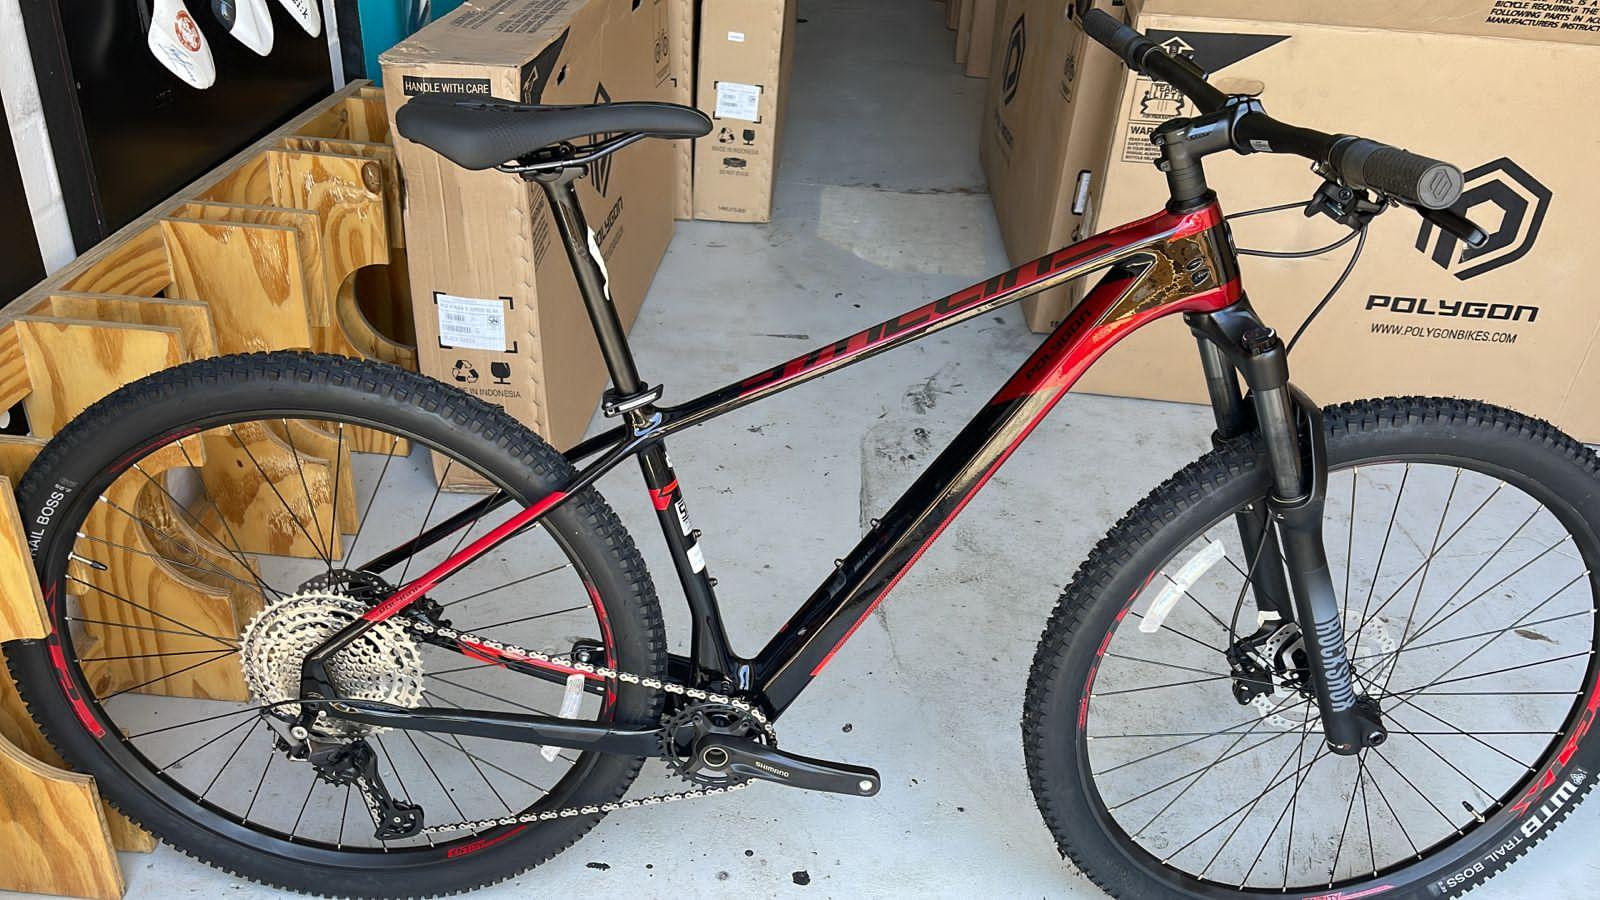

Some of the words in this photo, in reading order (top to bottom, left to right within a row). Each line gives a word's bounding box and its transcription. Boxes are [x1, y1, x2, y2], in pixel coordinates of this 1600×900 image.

[1490, 8, 1542, 18] FOLLOWING
[1543, 12, 1571, 21] PARTS
[1494, 1, 1531, 9] BICYCLE
[1531, 3, 1579, 13] REQUIRING
[1582, 7, 1600, 15] THE
[1485, 16, 1559, 28] MANUFACTURERS
[405, 81, 440, 93] HANDLE
[441, 83, 465, 93] WITH
[465, 83, 489, 94] CARE
[1365, 294, 1539, 322] POLYGON
[1371, 322, 1518, 344] WWW.POLYGONBIKES.COM
[479, 388, 521, 398] INDONESIA
[36, 491, 65, 525] BOSS
[1315, 617, 1356, 713] ROCKSHOX
[755, 760, 790, 778] SHIMANO
[1520, 780, 1579, 838] WTB
[1485, 834, 1524, 863] TRAIL
[1446, 861, 1485, 888] BOSS
